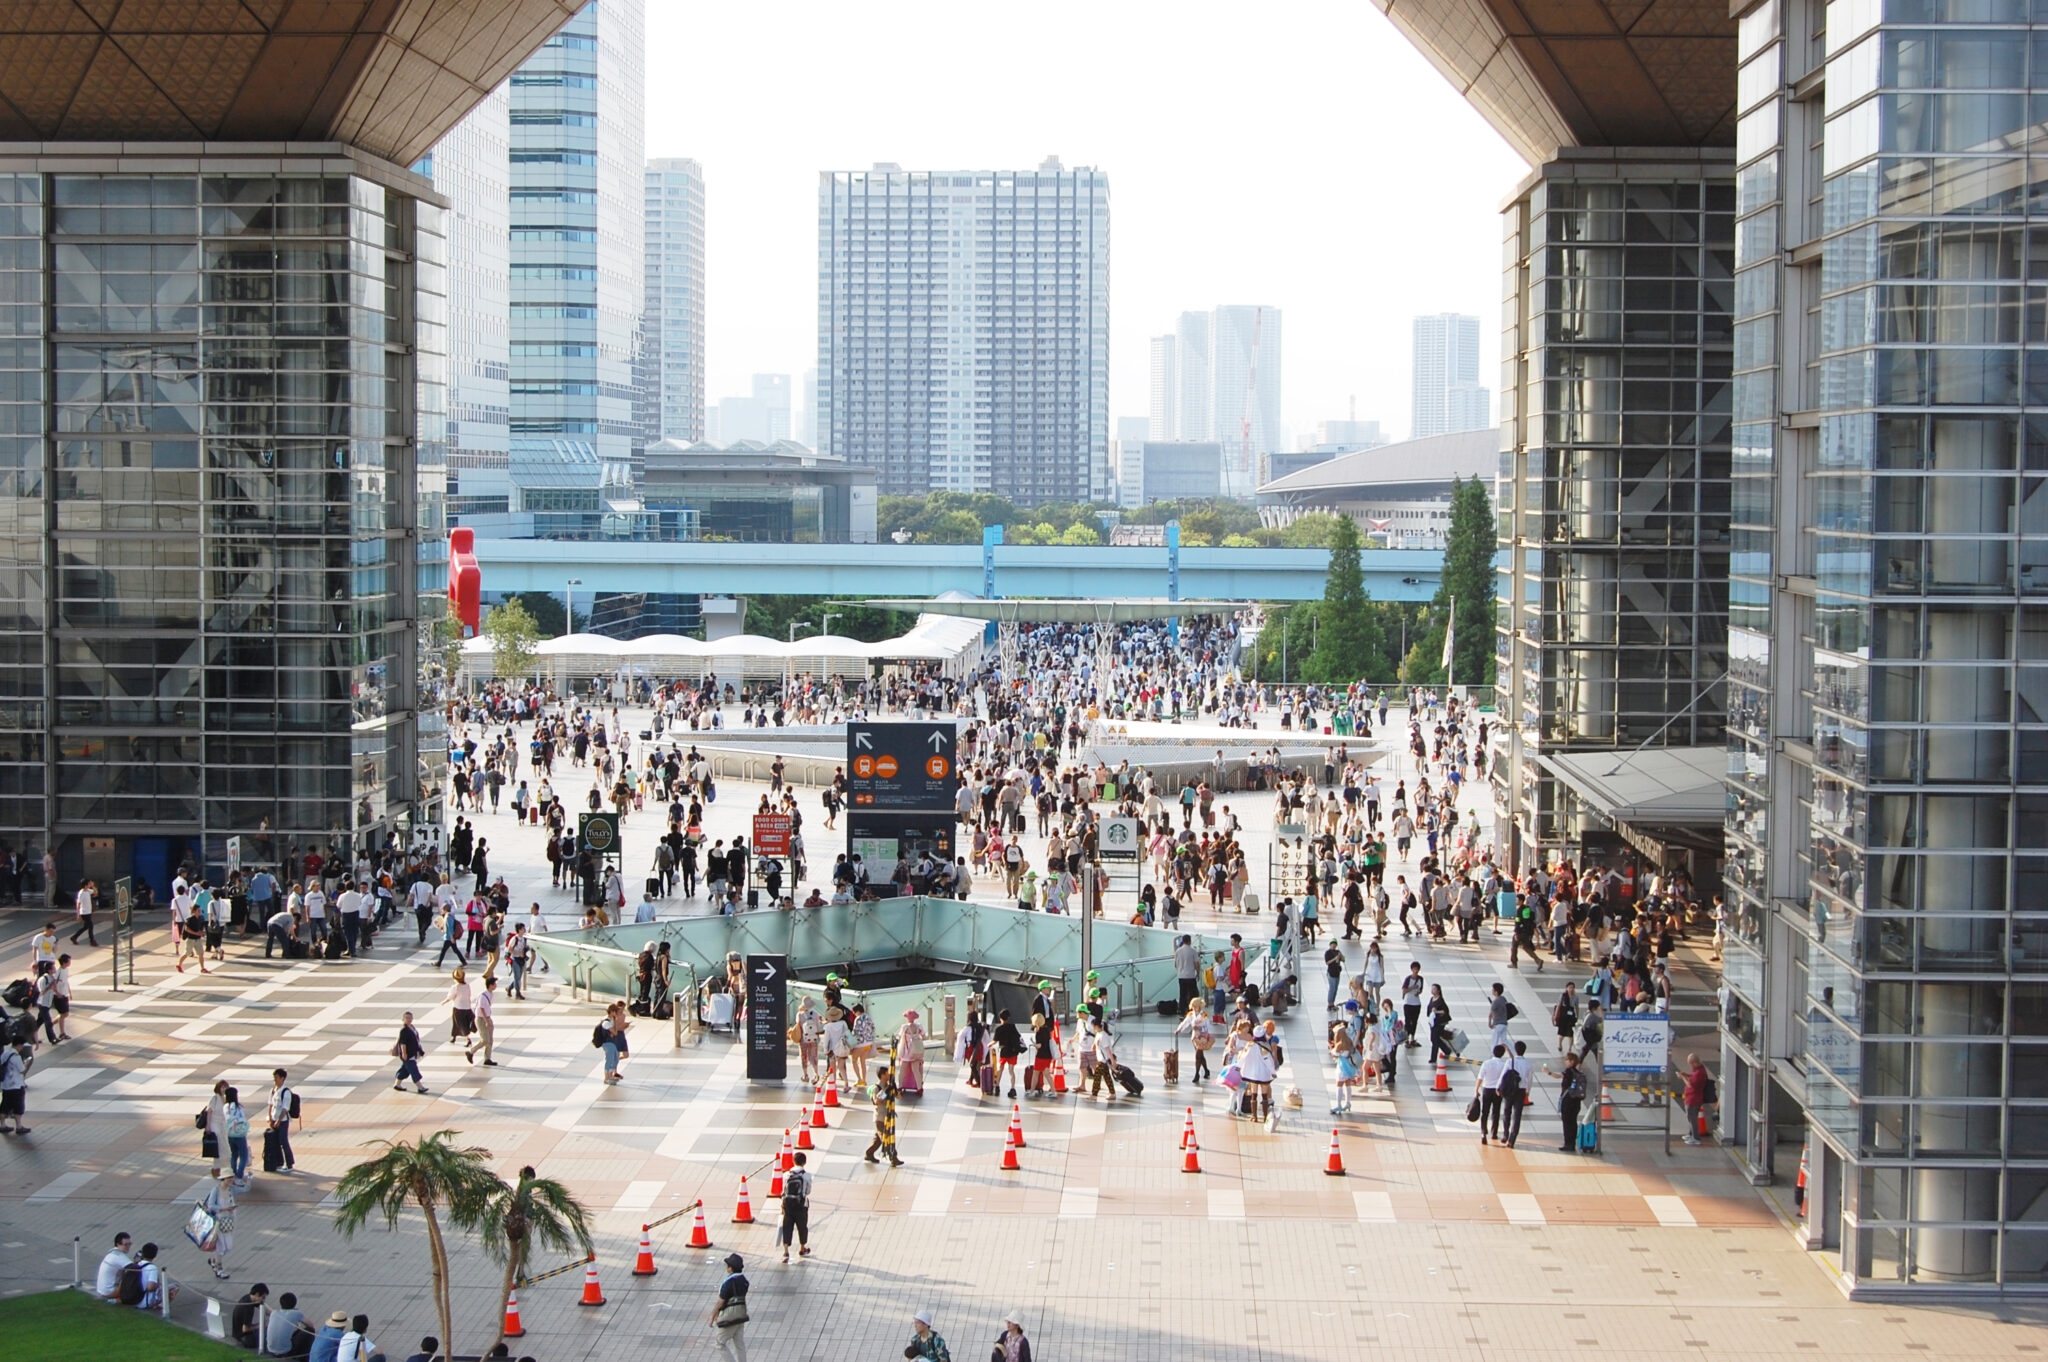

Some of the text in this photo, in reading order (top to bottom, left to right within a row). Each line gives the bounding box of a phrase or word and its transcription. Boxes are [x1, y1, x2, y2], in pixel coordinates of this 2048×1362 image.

[1644, 836, 1663, 868] SIGHT
[1281, 852, 1289, 896] ゆりかもめ
[1629, 1031, 1665, 1044] Porto
